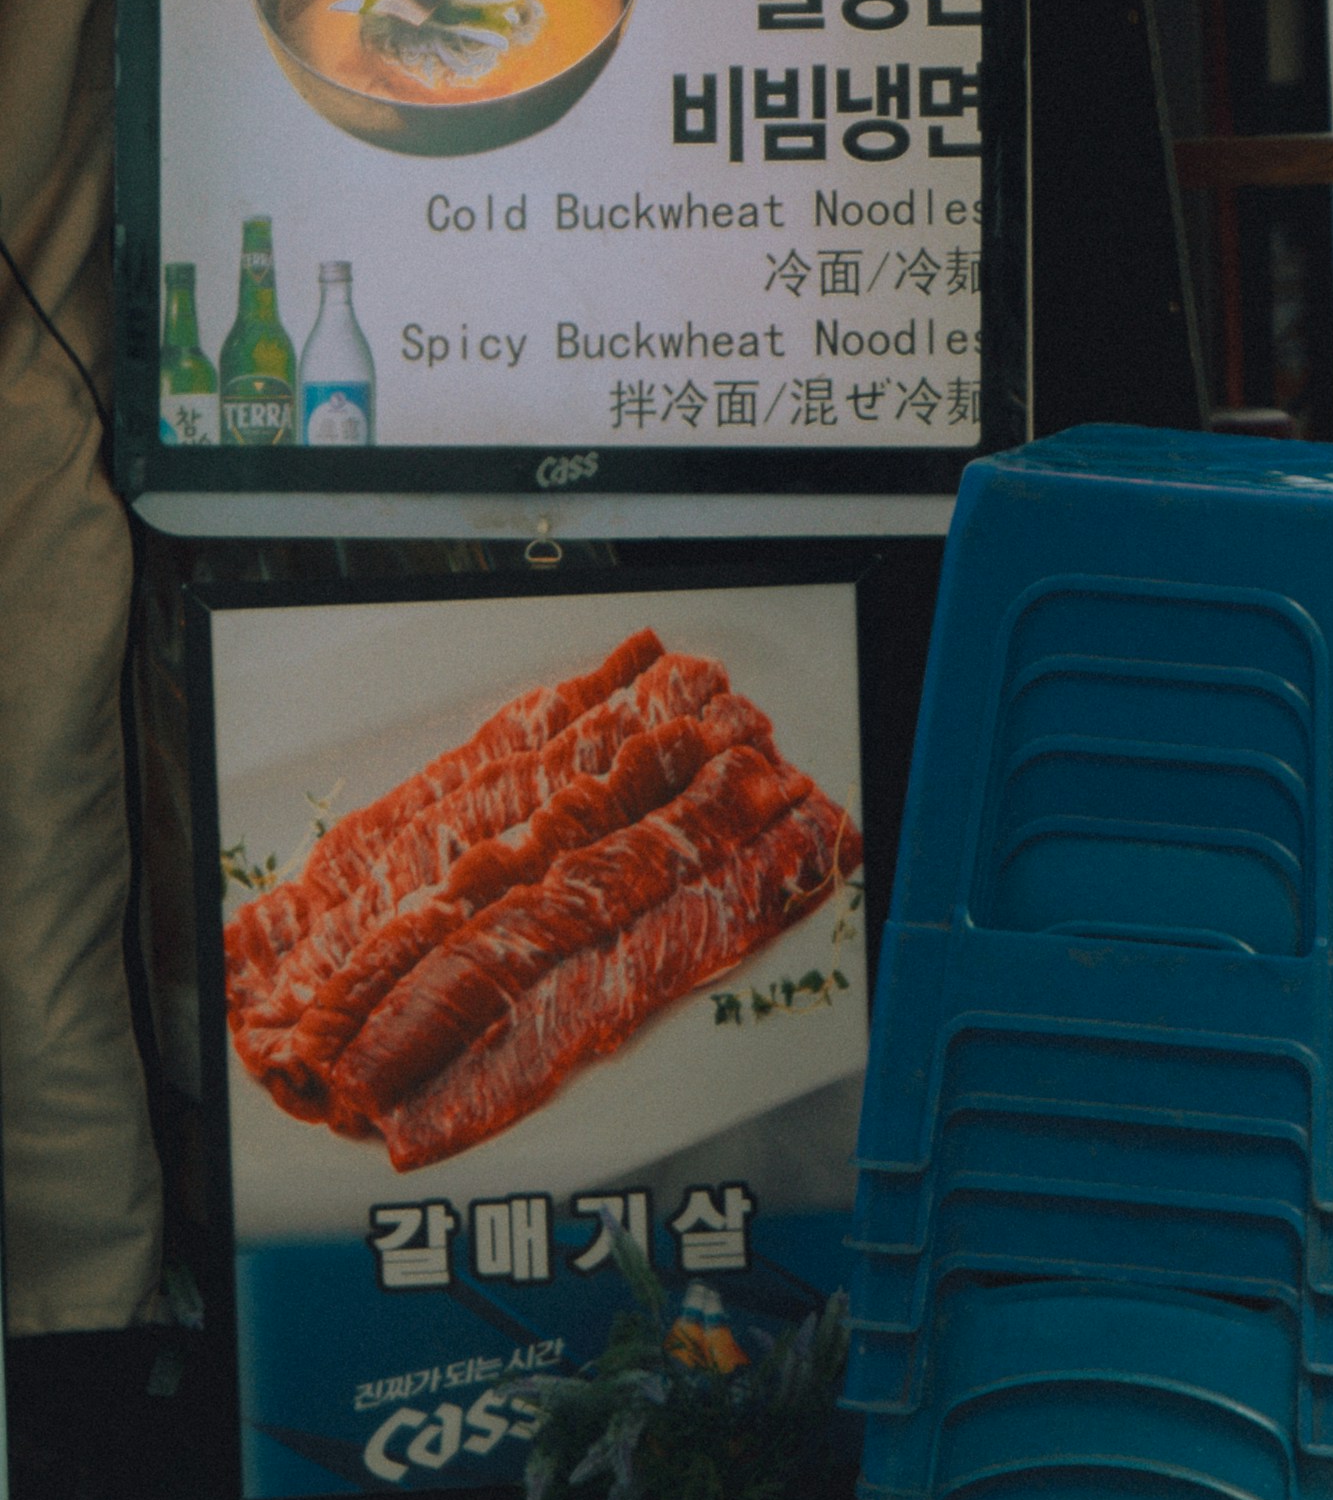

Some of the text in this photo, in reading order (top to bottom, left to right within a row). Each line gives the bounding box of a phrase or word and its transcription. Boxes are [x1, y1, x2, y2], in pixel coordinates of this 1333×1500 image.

[672, 62, 981, 163] 비빔냉면
[427, 193, 527, 232] Cold
[556, 192, 785, 231] Buckwheat
[401, 322, 527, 367] Spicy
[556, 321, 785, 360] Buckwheat
[225, 402, 293, 431] TERRA
[372, 1186, 753, 1290] 갈매기살
[443, 1355, 503, 1390] 되는
[503, 1338, 566, 1372] 시간
